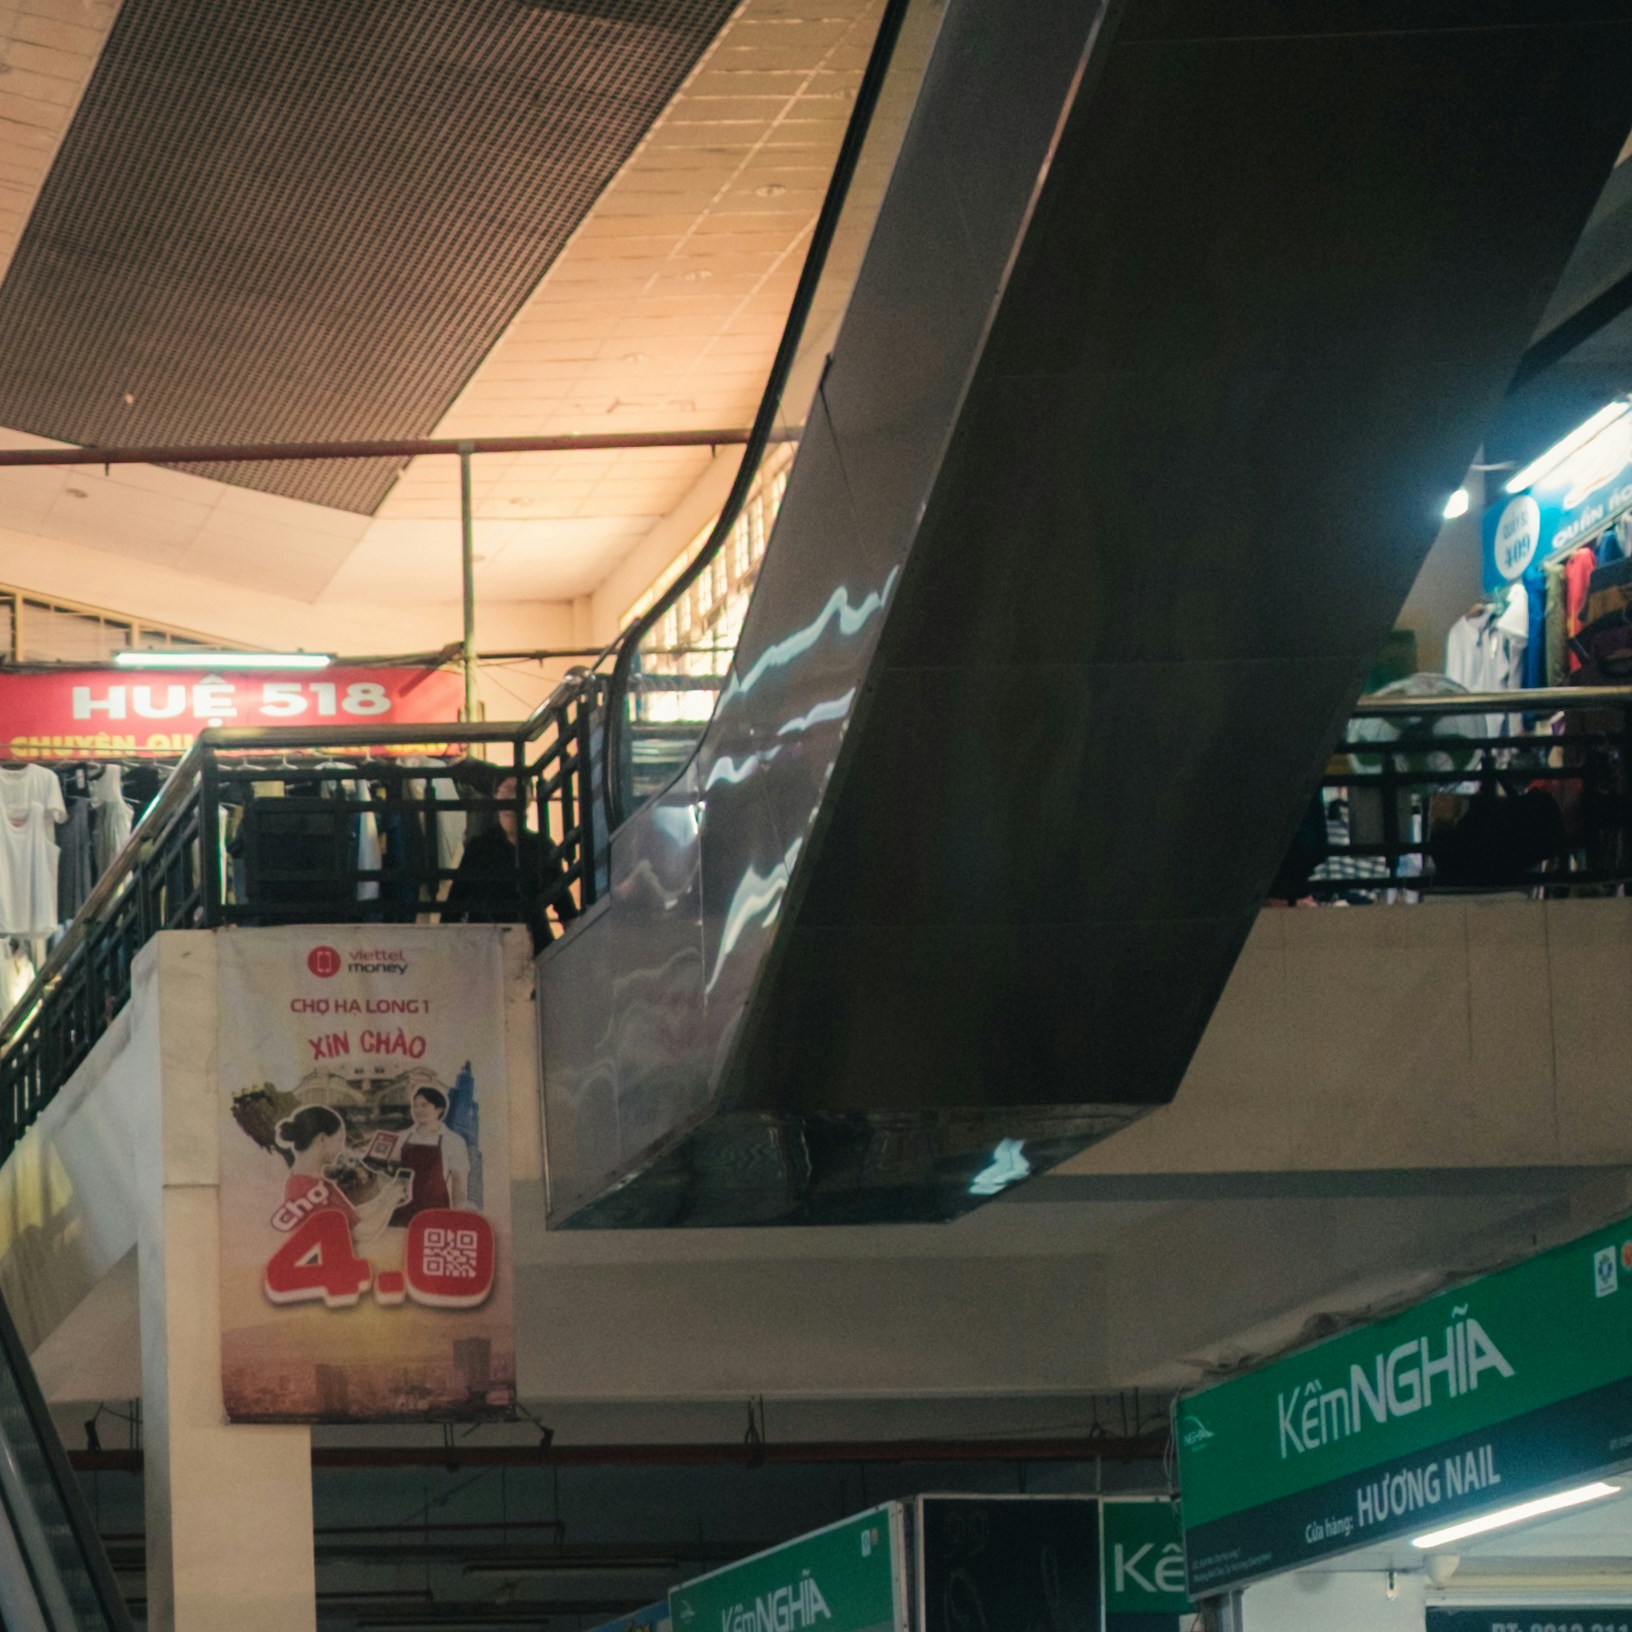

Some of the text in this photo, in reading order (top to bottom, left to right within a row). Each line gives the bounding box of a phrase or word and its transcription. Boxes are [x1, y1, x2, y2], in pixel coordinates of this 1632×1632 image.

[72, 674, 392, 728] HUỆ 518
[348, 948, 405, 962] viettel
[347, 962, 409, 976] money
[290, 998, 330, 1015] CHỢ
[333, 999, 363, 1018] HẠ
[366, 999, 419, 1014] LONG
[360, 1027, 427, 1059] CHÀO
[1356, 1456, 1442, 1529] HƯƠNG
[1444, 1443, 1502, 1500] NAIL
